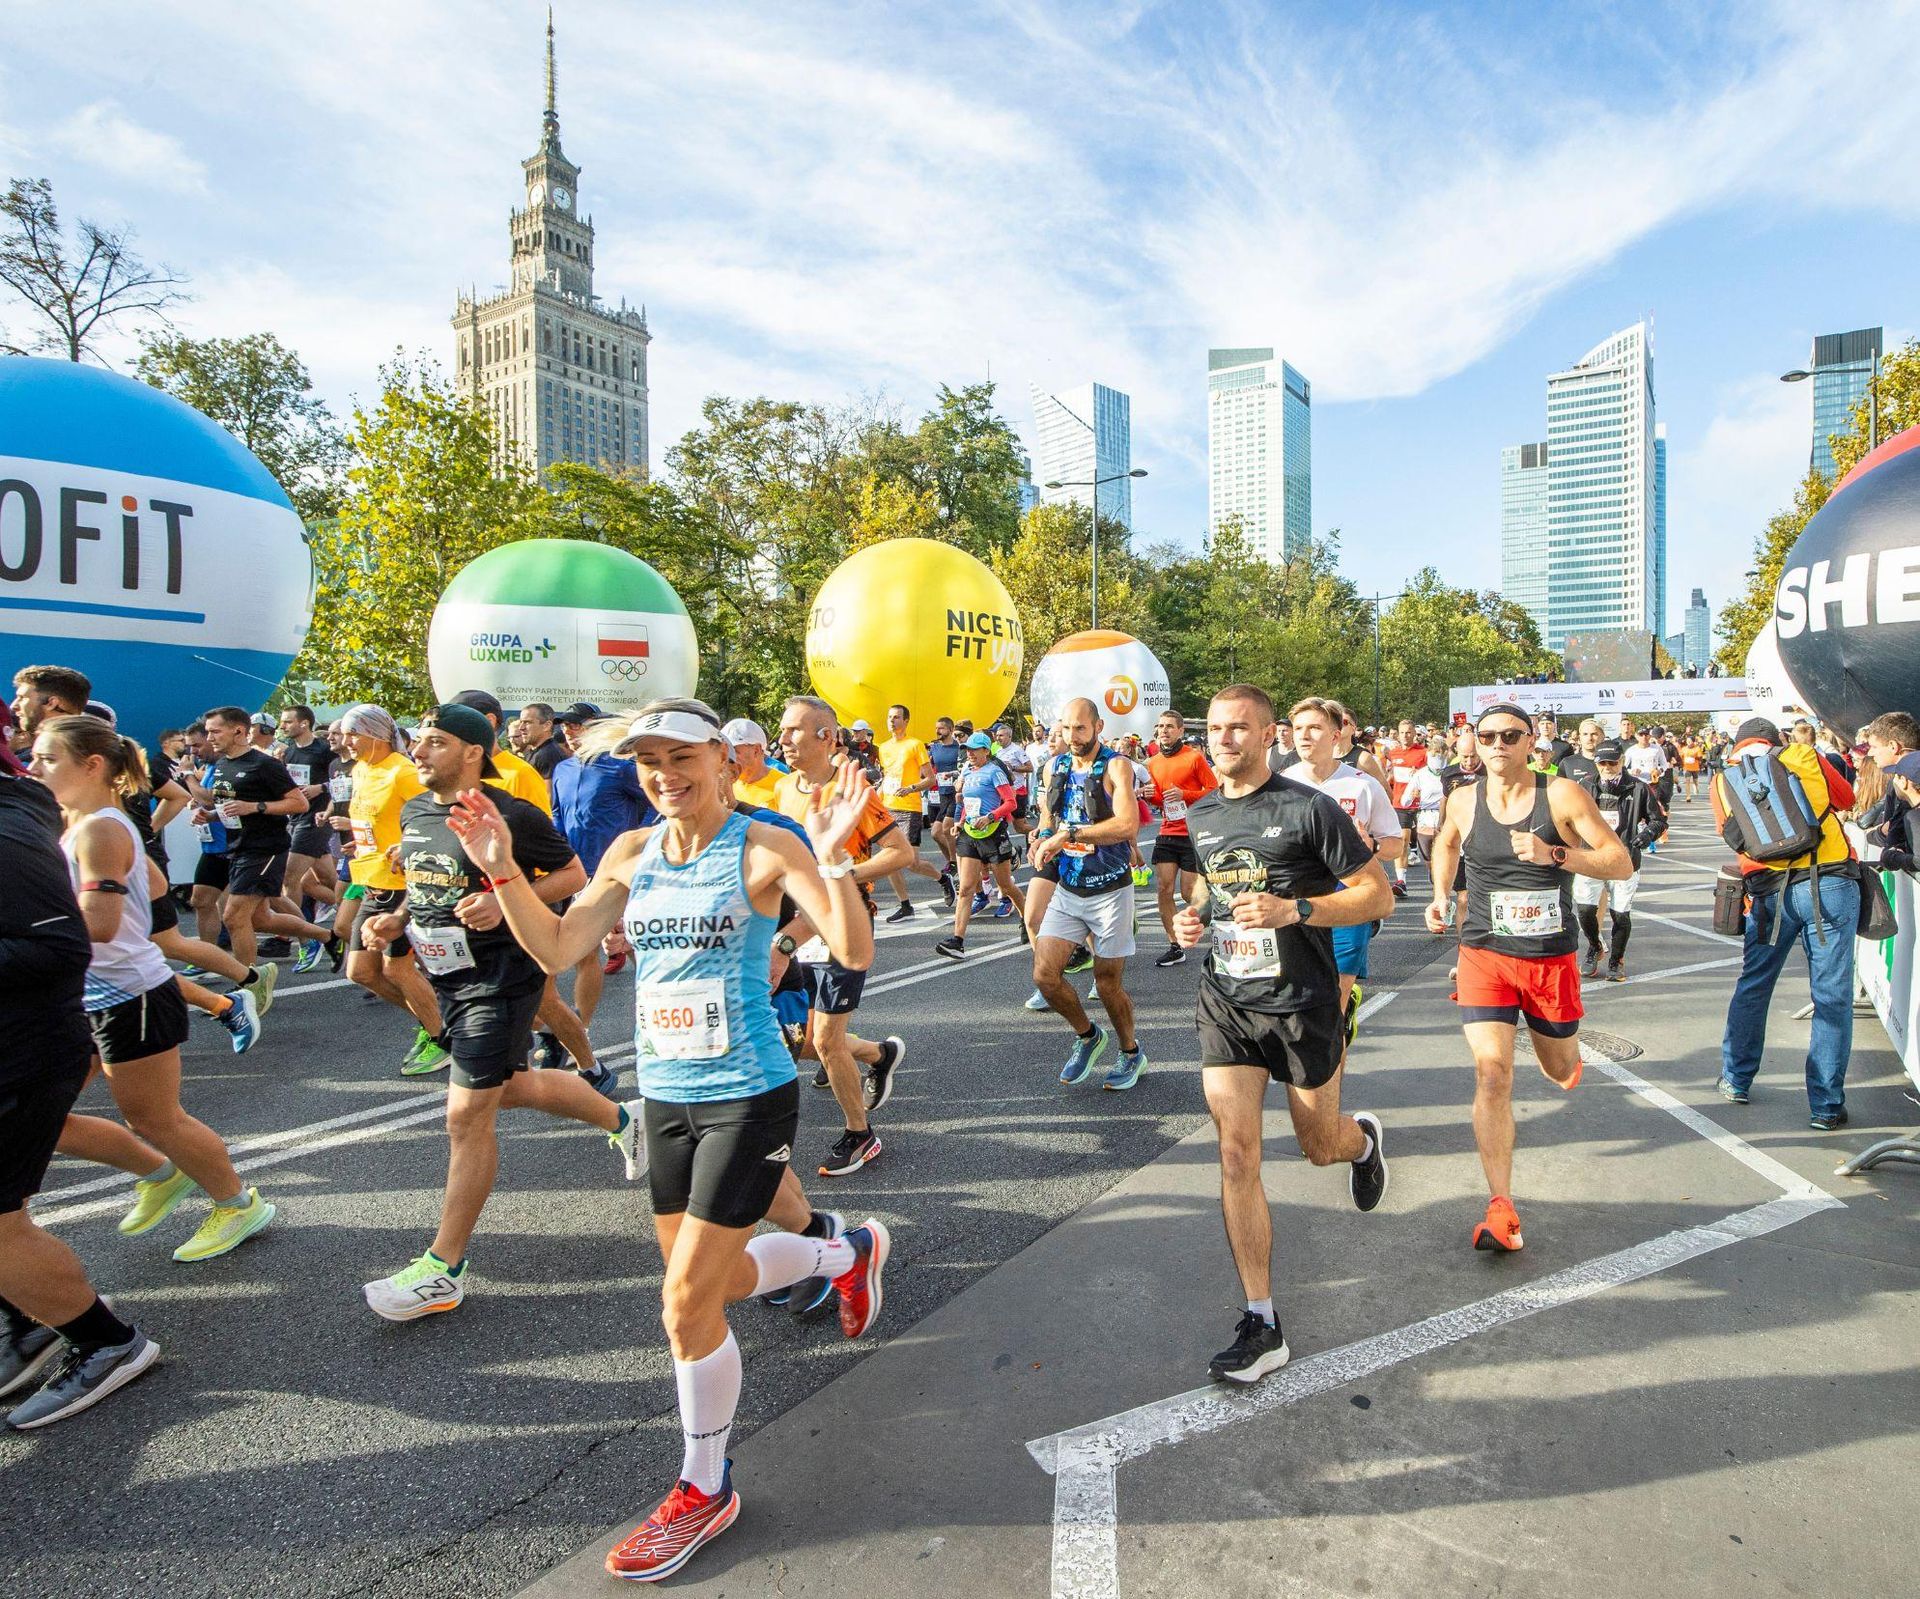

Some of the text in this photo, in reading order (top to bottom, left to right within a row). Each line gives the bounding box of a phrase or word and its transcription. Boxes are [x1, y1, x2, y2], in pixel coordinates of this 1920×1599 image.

[947, 609, 1021, 642] NICE TO
[471, 633, 522, 647] GRUPA
[946, 635, 987, 660] FIT
[470, 648, 533, 663] LUXMED
[496, 686, 624, 696] GŁÓWNY PARTNER MEDYCZNY
[1652, 700, 1684, 710] 2:12
[1511, 905, 1542, 919] 7386
[1222, 939, 1258, 956] 11705
[652, 1007, 695, 1029] 4560
